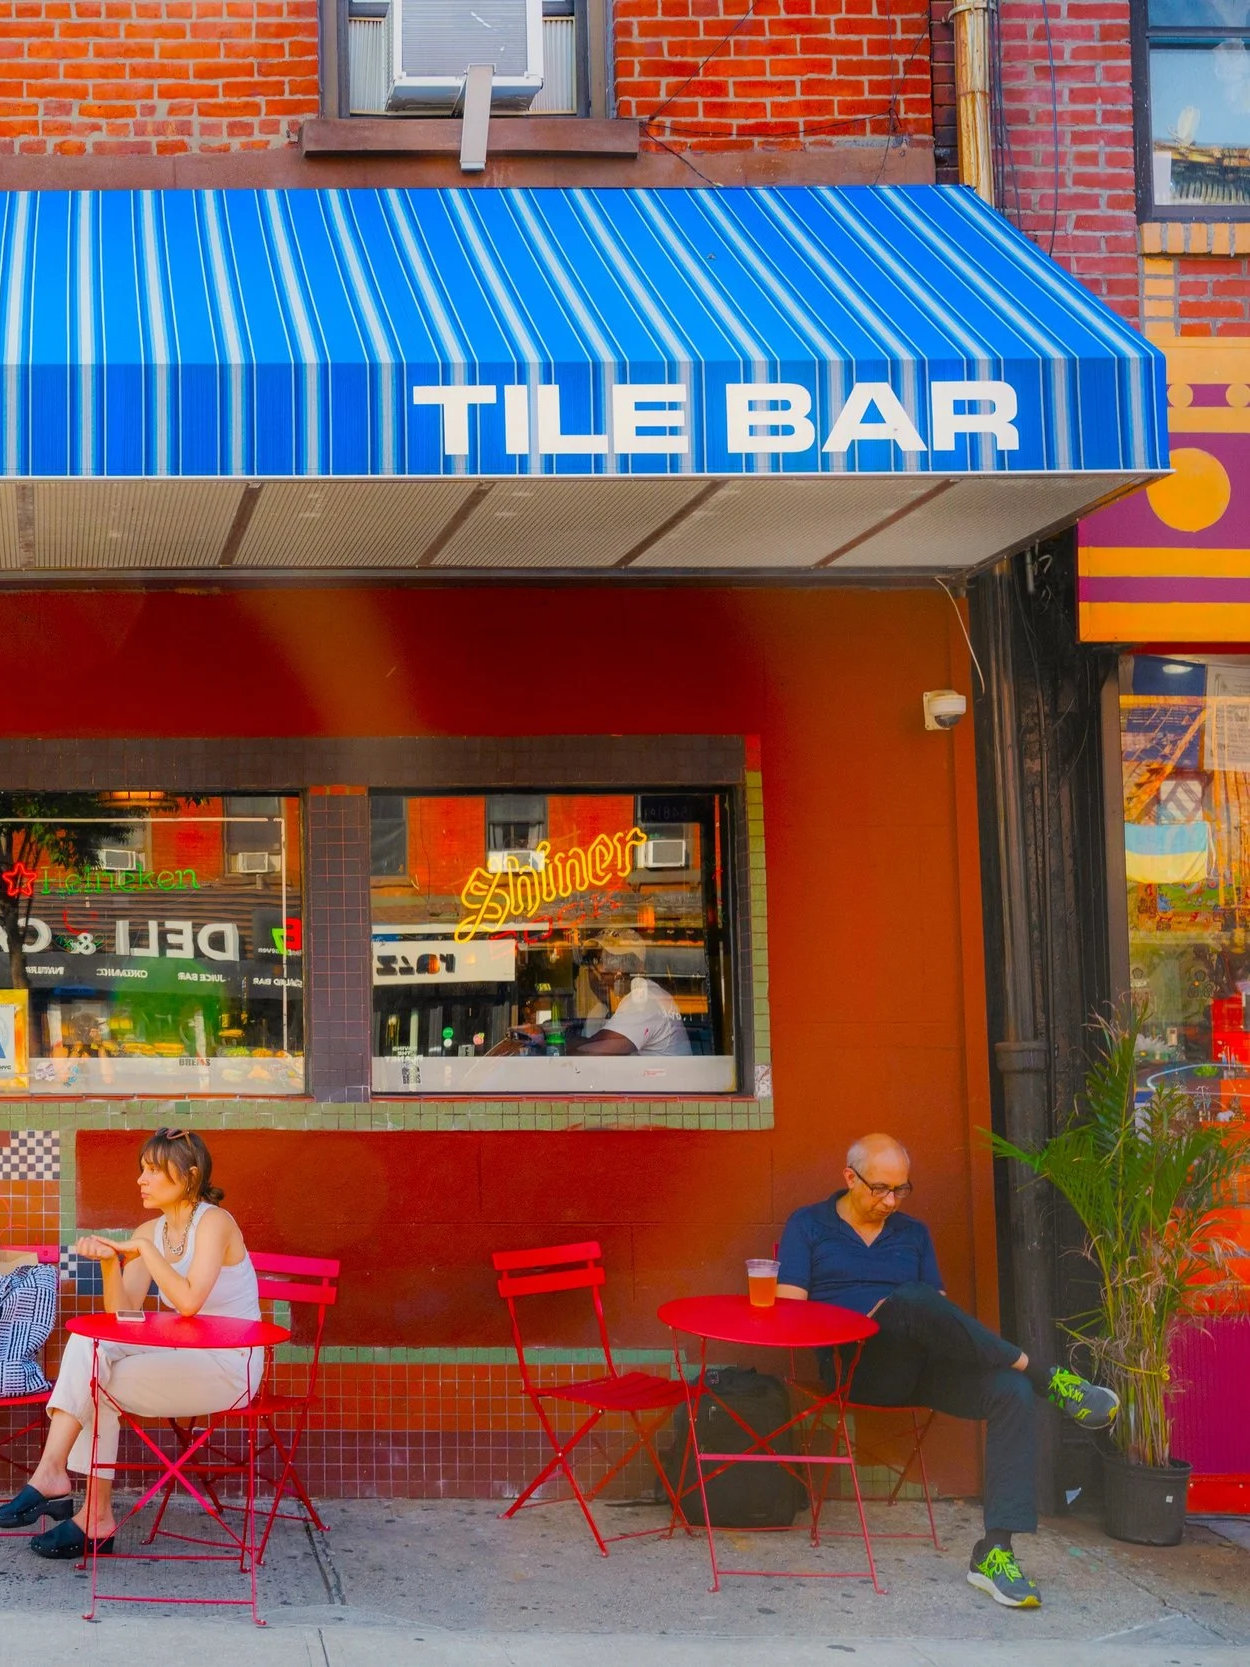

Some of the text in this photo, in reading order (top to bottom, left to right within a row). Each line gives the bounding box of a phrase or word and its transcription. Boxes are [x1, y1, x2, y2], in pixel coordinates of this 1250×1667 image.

[413, 381, 1019, 455] TILE BAR
[40, 862, 200, 896] Heineken
[454, 827, 647, 944] Shiner
